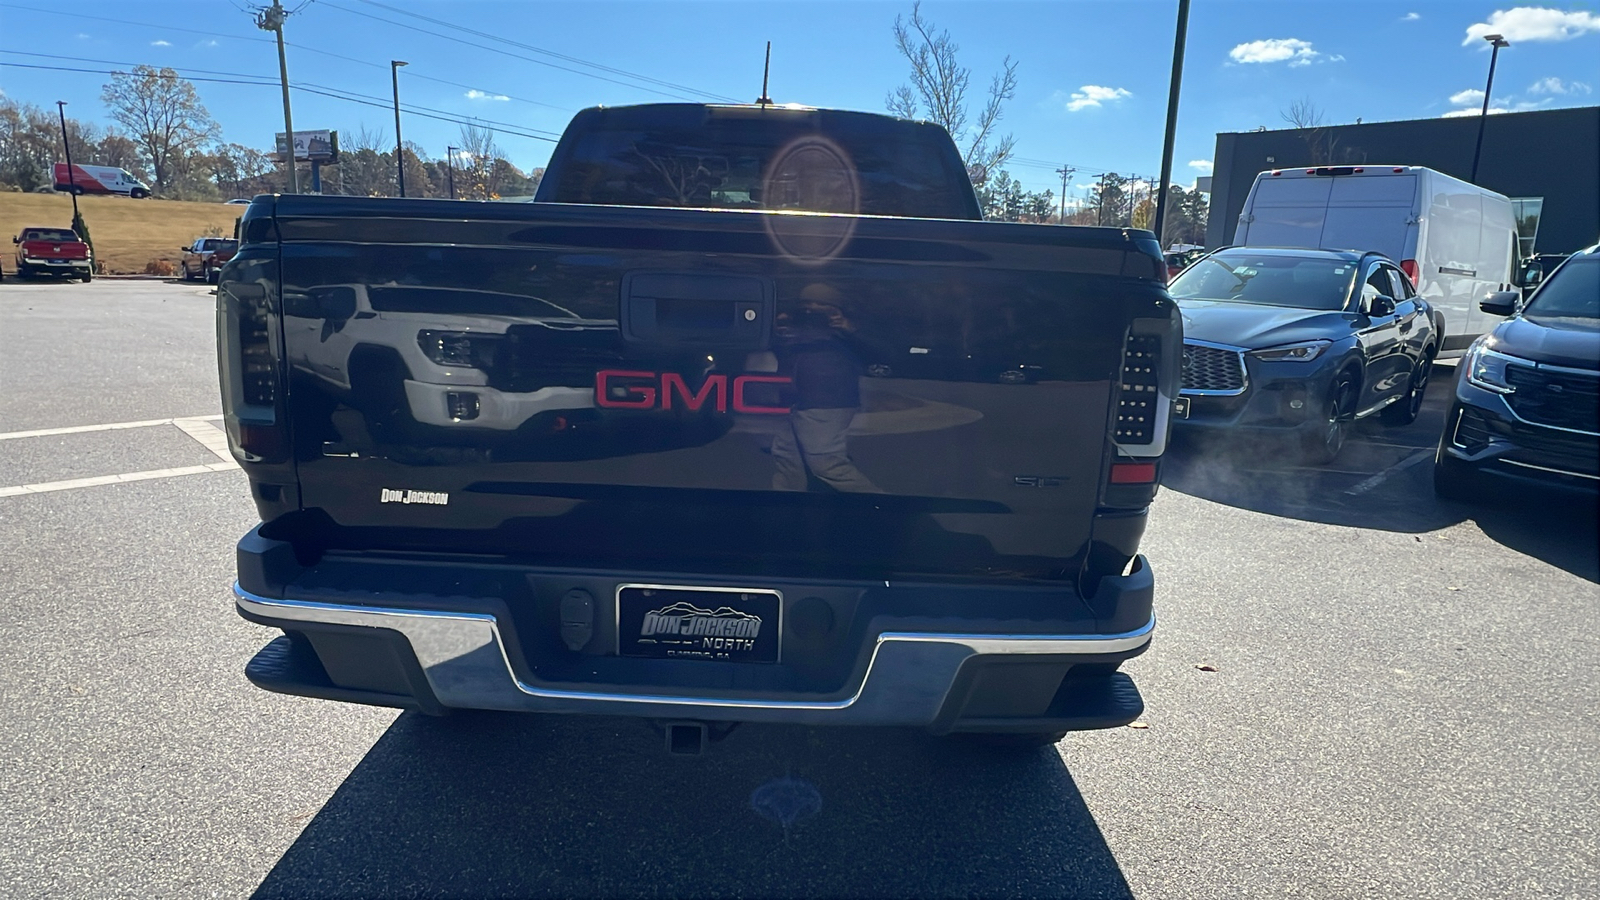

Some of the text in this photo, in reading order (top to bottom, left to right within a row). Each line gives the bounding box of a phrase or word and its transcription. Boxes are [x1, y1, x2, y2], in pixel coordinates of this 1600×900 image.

[596, 370, 793, 414] GMC
[381, 488, 448, 504] DON JACKSON
[640, 613, 762, 638] DON JACKSON
[702, 637, 754, 651] NORTH
